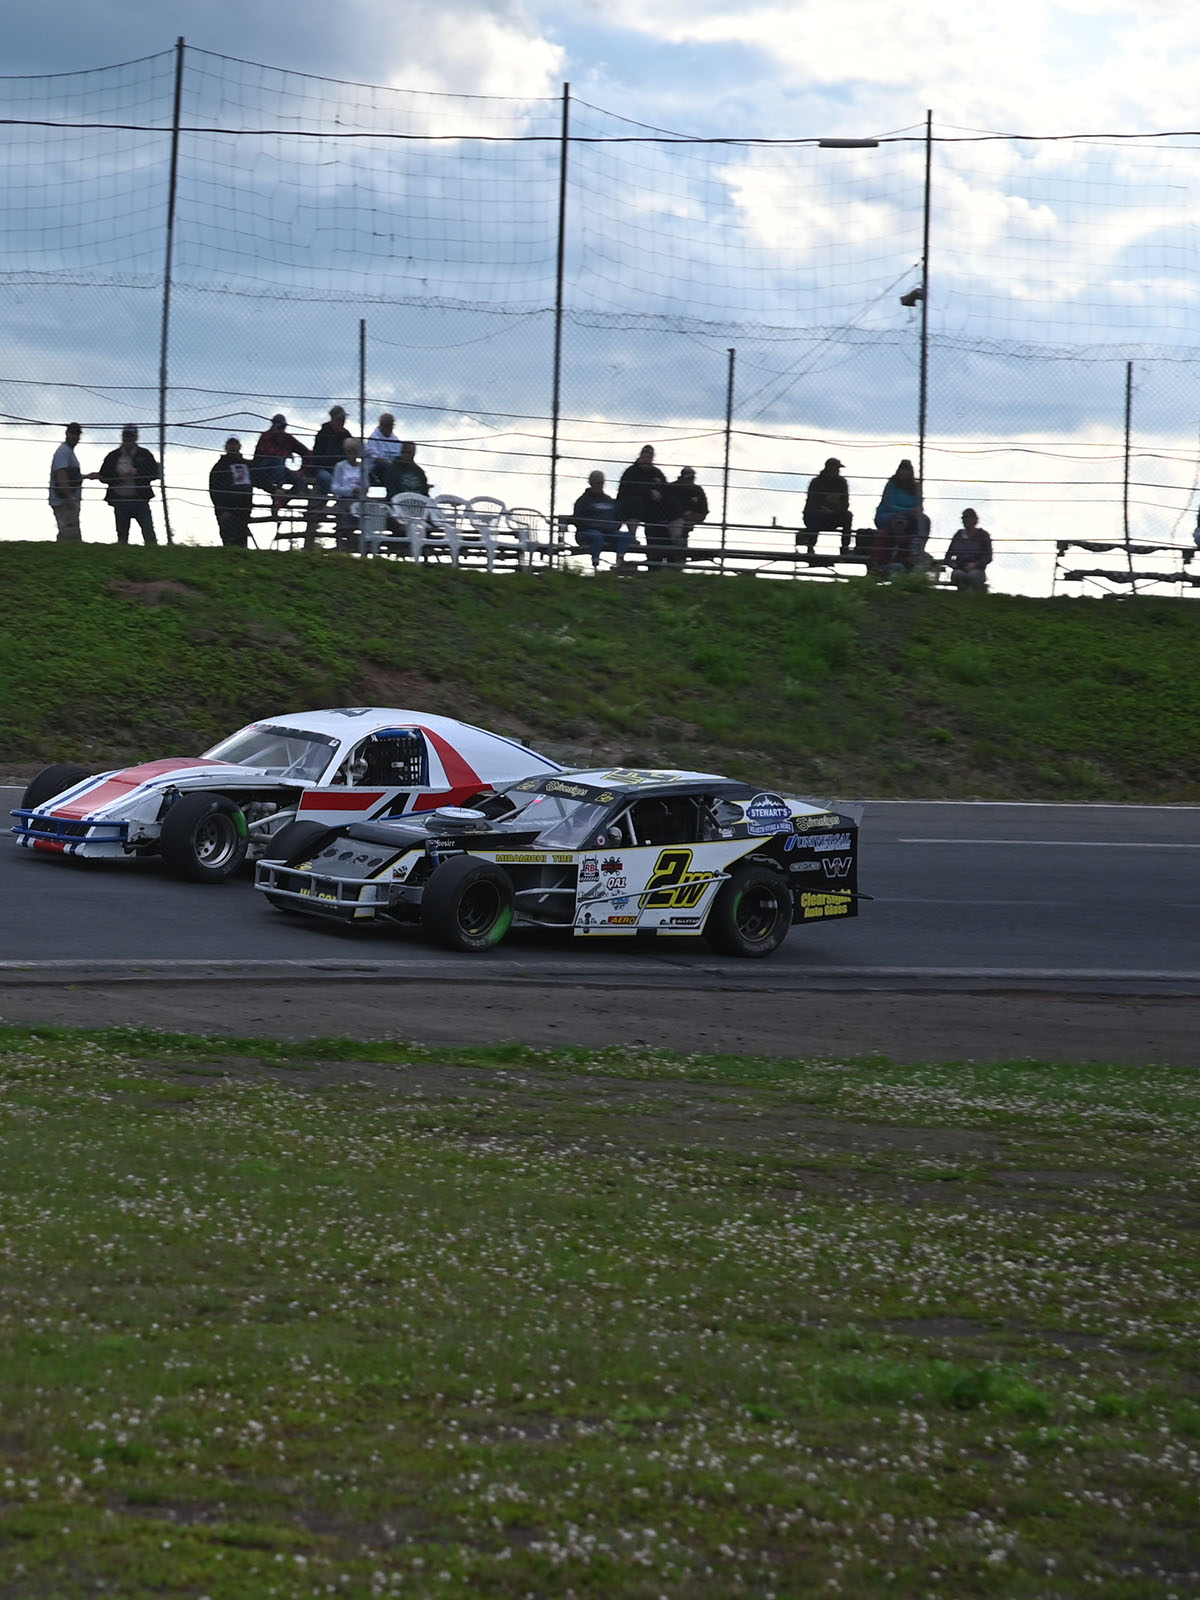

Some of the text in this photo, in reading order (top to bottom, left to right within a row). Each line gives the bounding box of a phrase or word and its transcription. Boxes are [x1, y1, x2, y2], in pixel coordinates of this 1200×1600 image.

[751, 808, 788, 817] STEWART'S
[496, 854, 573, 863] MIRAMICHI TIRE
[804, 904, 848, 918] Auto Glass
[611, 916, 637, 925] AERO
